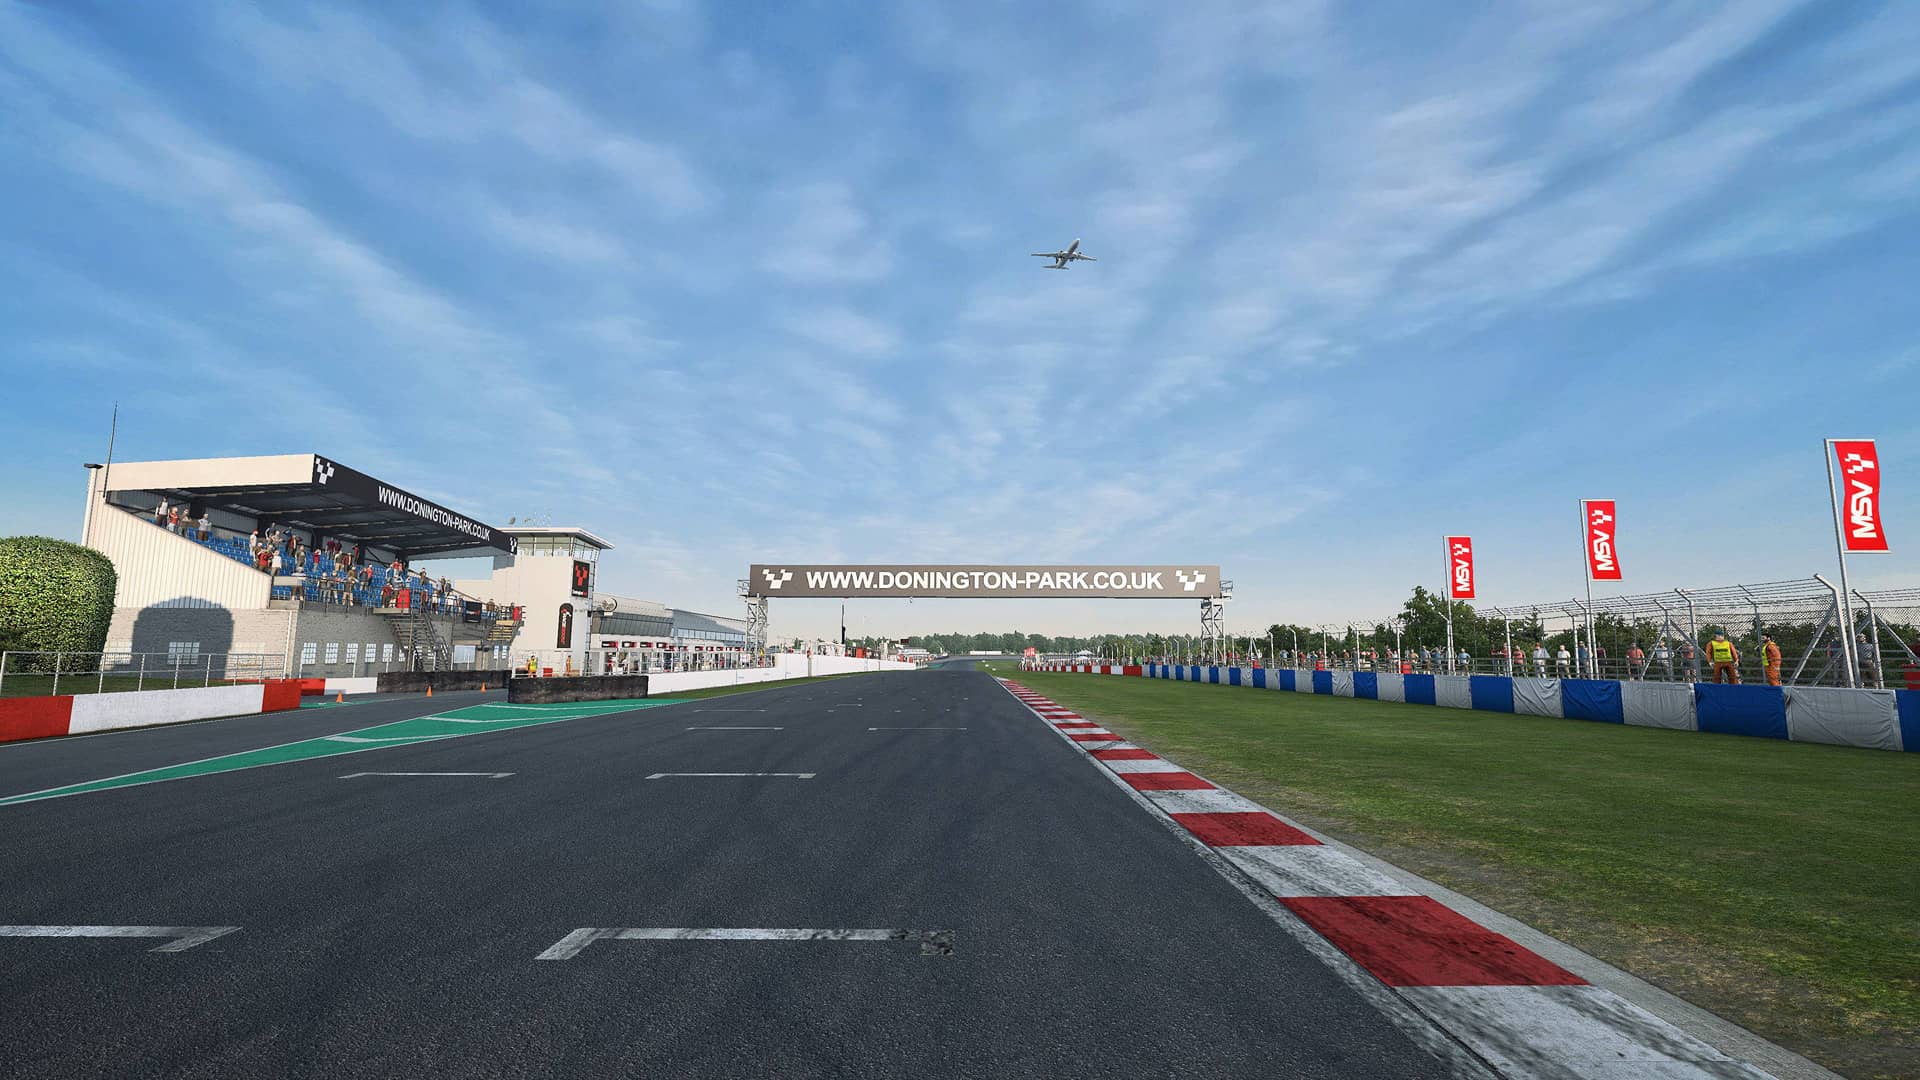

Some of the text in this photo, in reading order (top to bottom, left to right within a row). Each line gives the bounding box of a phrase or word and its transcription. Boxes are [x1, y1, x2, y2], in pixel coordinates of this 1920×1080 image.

[378, 486, 490, 541] WWW.DONINGTON-PARK.CO.UK
[1850, 480, 1877, 538] MSV
[1593, 529, 1615, 571] MSV
[806, 571, 1164, 590] WWW.DONINGTON-PARK.CO.UK
[1455, 559, 1470, 592] MSV
